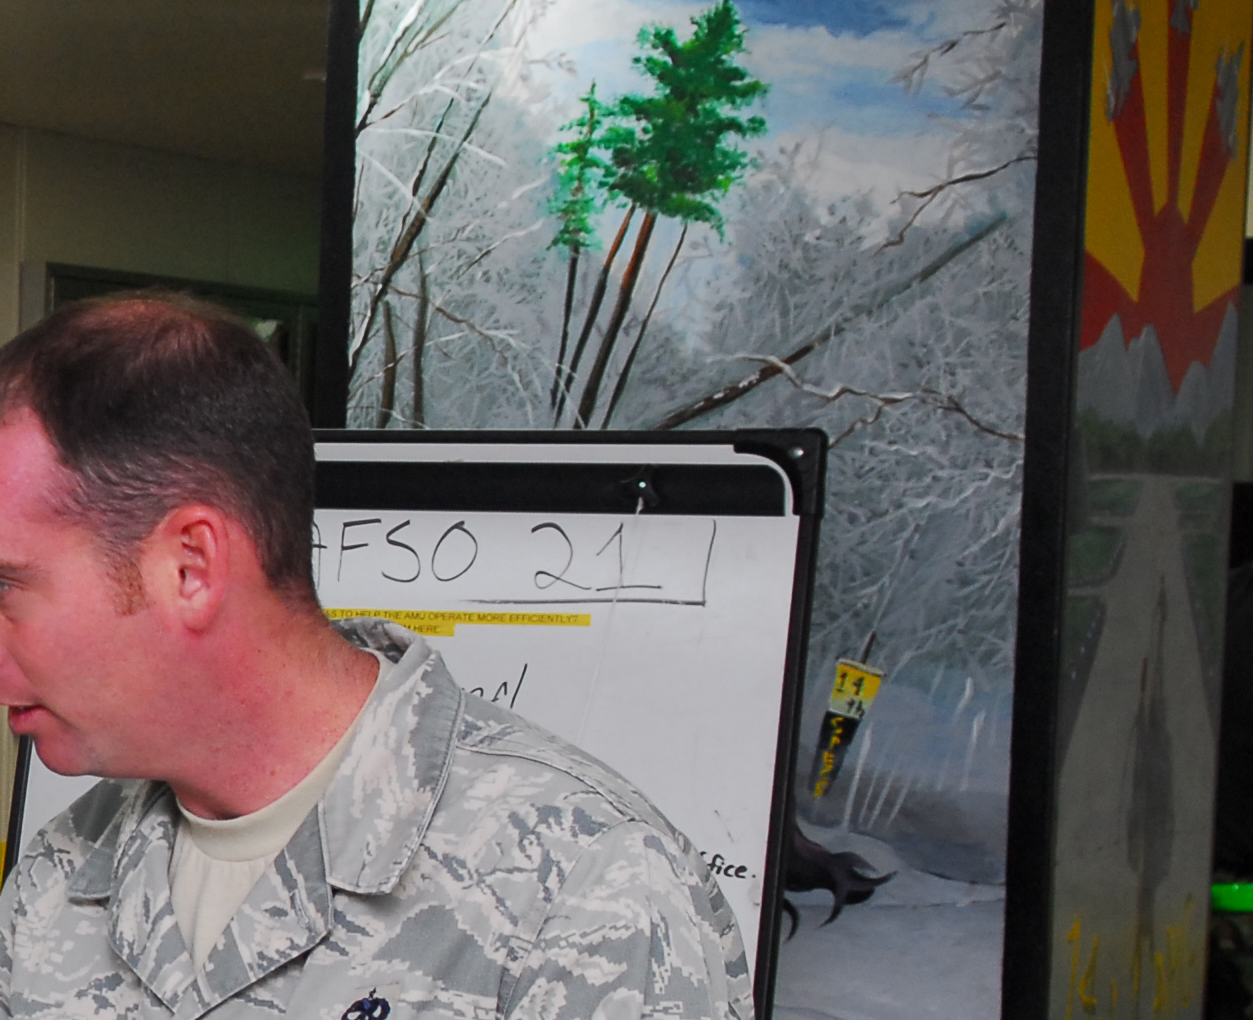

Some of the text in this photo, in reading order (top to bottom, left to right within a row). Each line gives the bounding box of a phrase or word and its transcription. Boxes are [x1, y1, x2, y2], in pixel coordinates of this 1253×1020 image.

[339, 610, 354, 618] TO
[355, 610, 381, 618] HELP
[384, 611, 402, 620] THE
[428, 611, 474, 622] OPERATE
[477, 613, 507, 622] MORE
[509, 614, 579, 624] EFFICIENTLY?
[413, 624, 441, 634] HERE
[835, 671, 866, 697] 14
[699, 850, 756, 880] fice.
